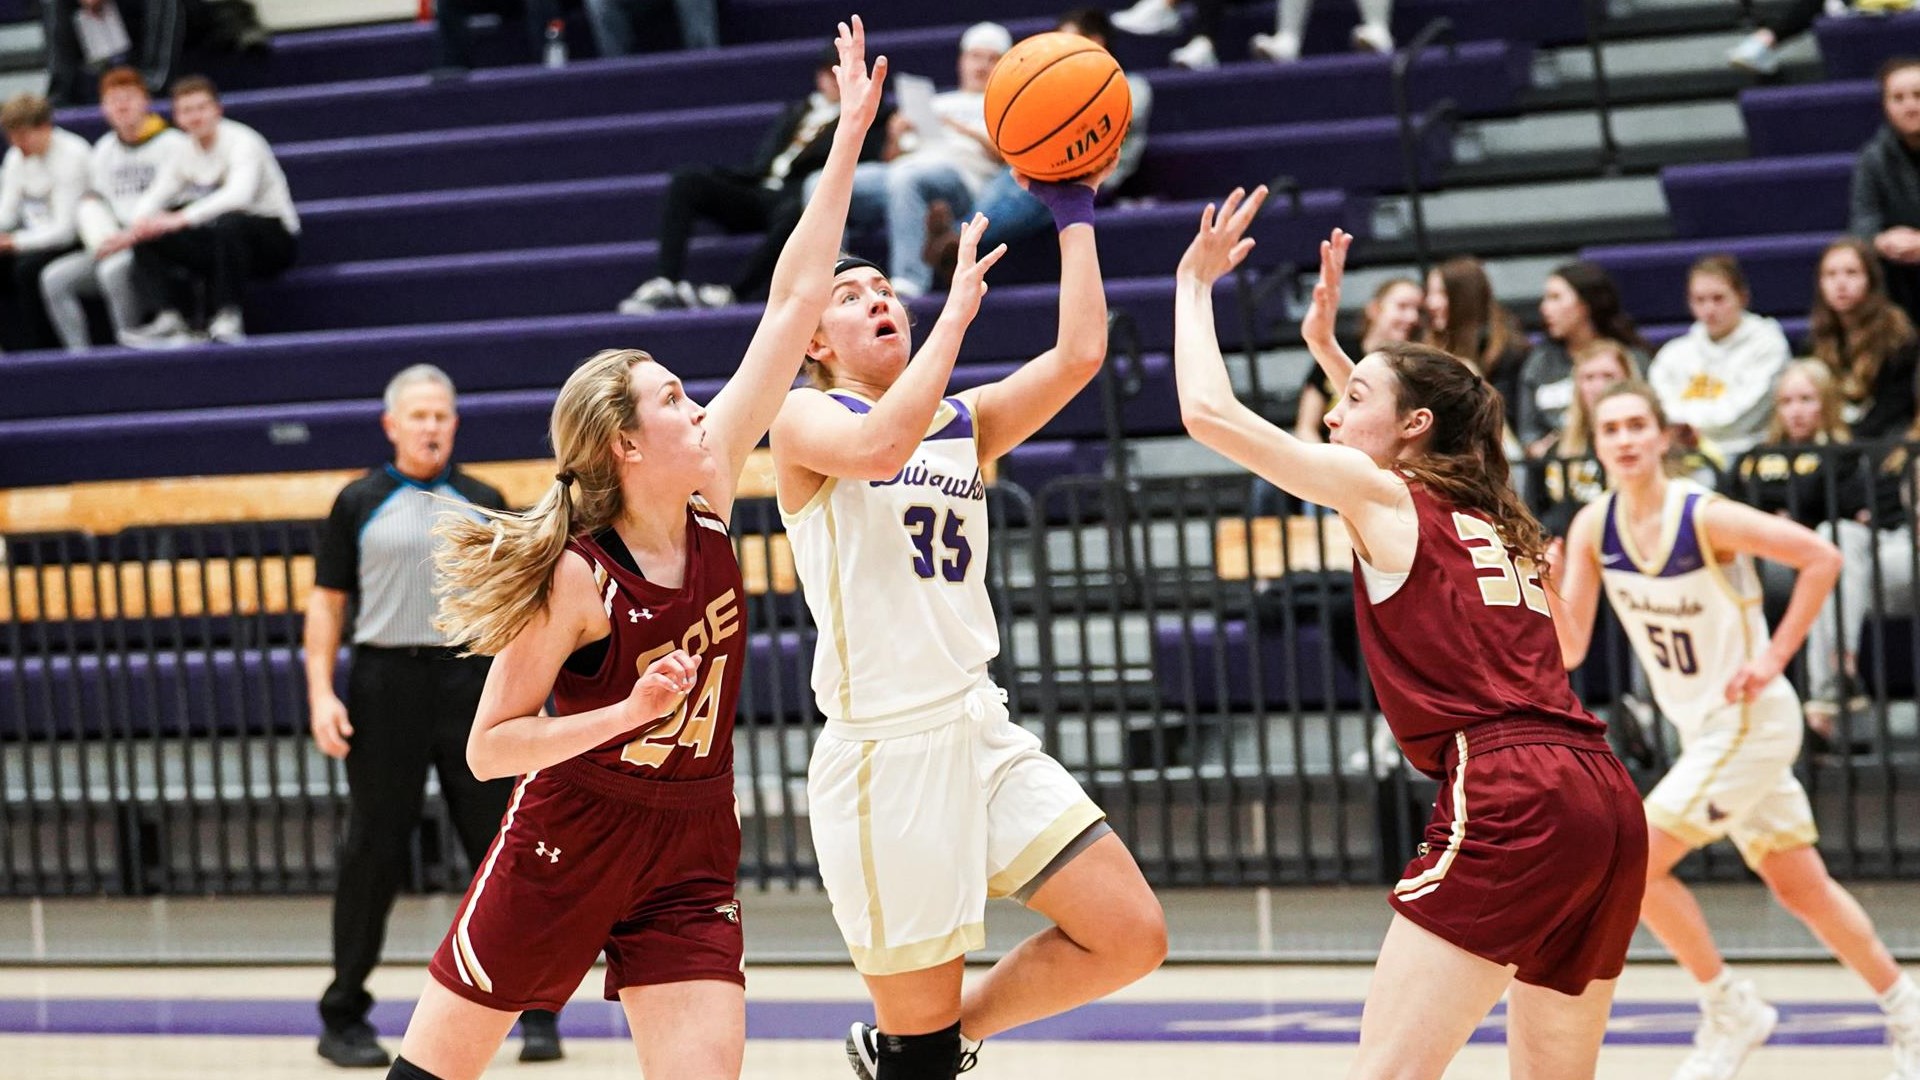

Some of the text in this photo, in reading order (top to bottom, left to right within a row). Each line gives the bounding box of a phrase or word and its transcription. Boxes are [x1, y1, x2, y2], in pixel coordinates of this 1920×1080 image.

[1066, 113, 1112, 162] EVO
[903, 504, 973, 583] 35
[1645, 623, 1698, 675] 50
[620, 654, 728, 769] 24
